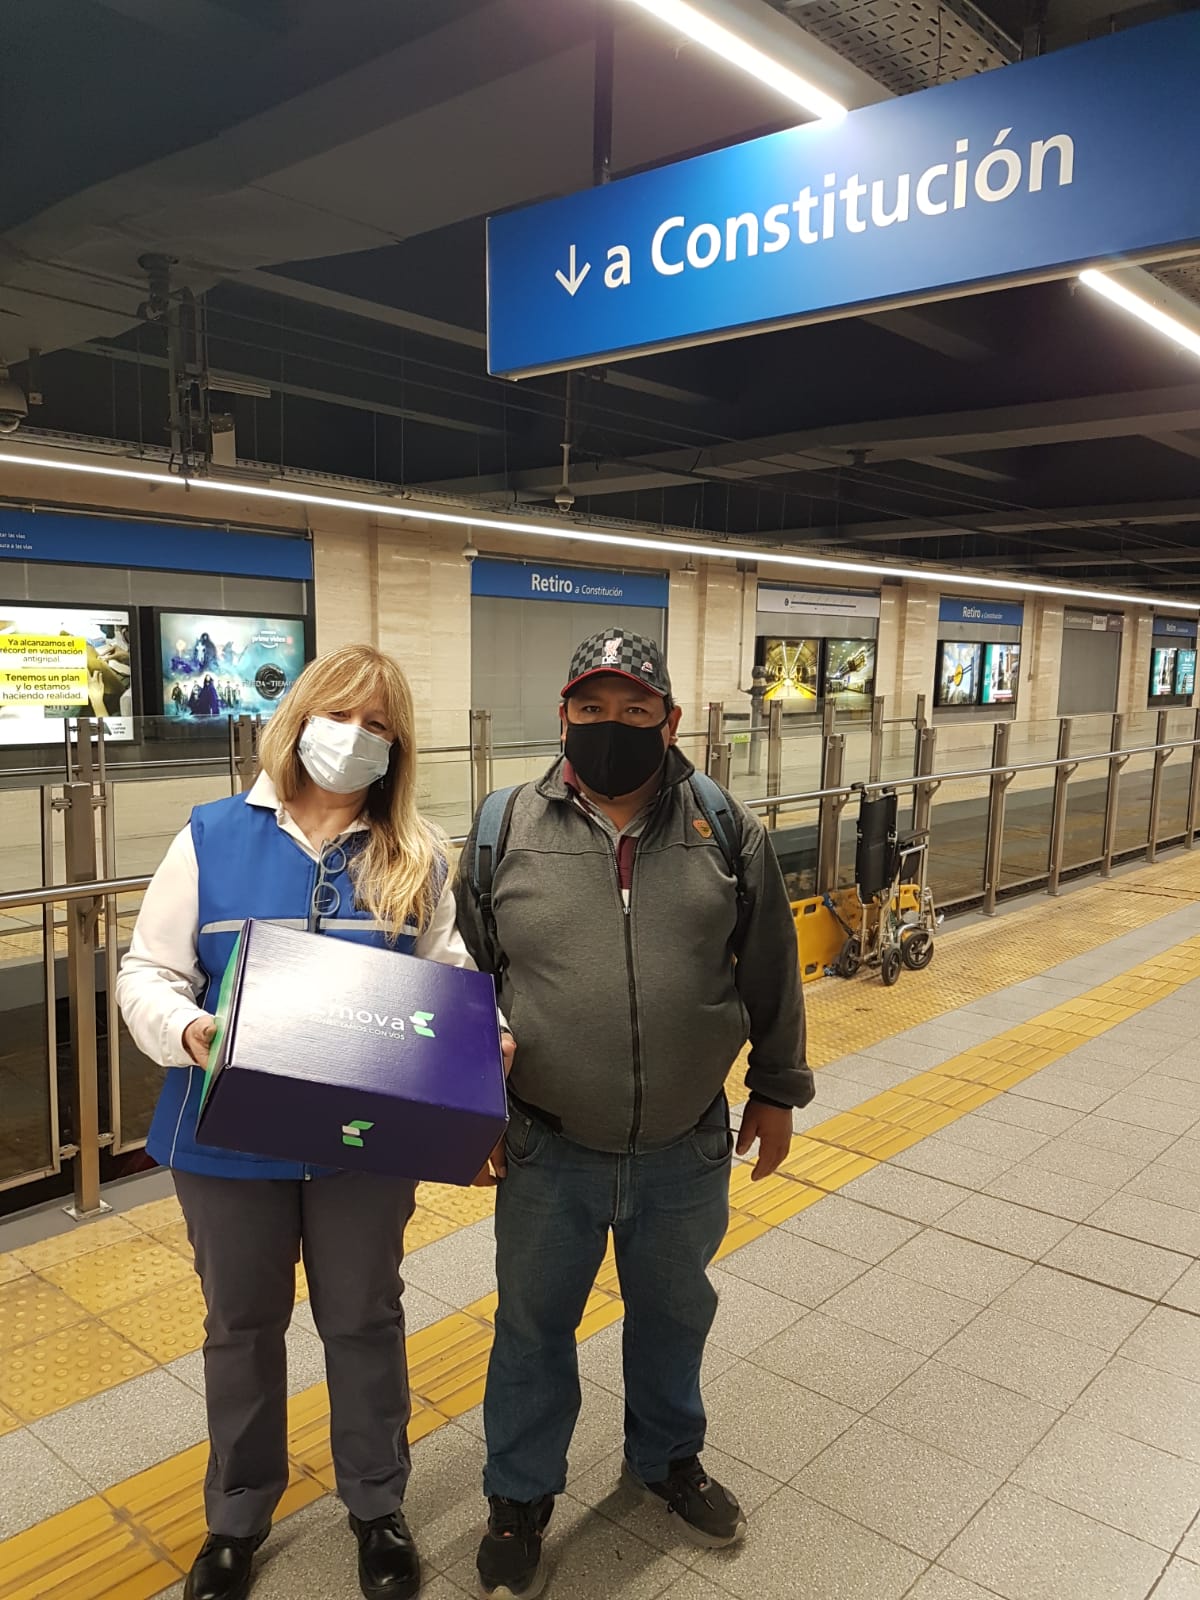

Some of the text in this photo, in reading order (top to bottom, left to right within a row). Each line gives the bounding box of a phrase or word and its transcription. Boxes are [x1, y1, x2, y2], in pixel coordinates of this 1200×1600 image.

[603, 127, 1075, 289] a Constitución
[531, 573, 623, 598] Retiro a Constitución
[962, 606, 981, 618] Retiro
[20, 639, 66, 647] alcanzamos
[39, 647, 83, 655] vacunación
[5, 673, 46, 682] Tenemos
[61, 674, 80, 684] plan
[15, 684, 21, 692] y
[2, 691, 44, 700] haciendo
